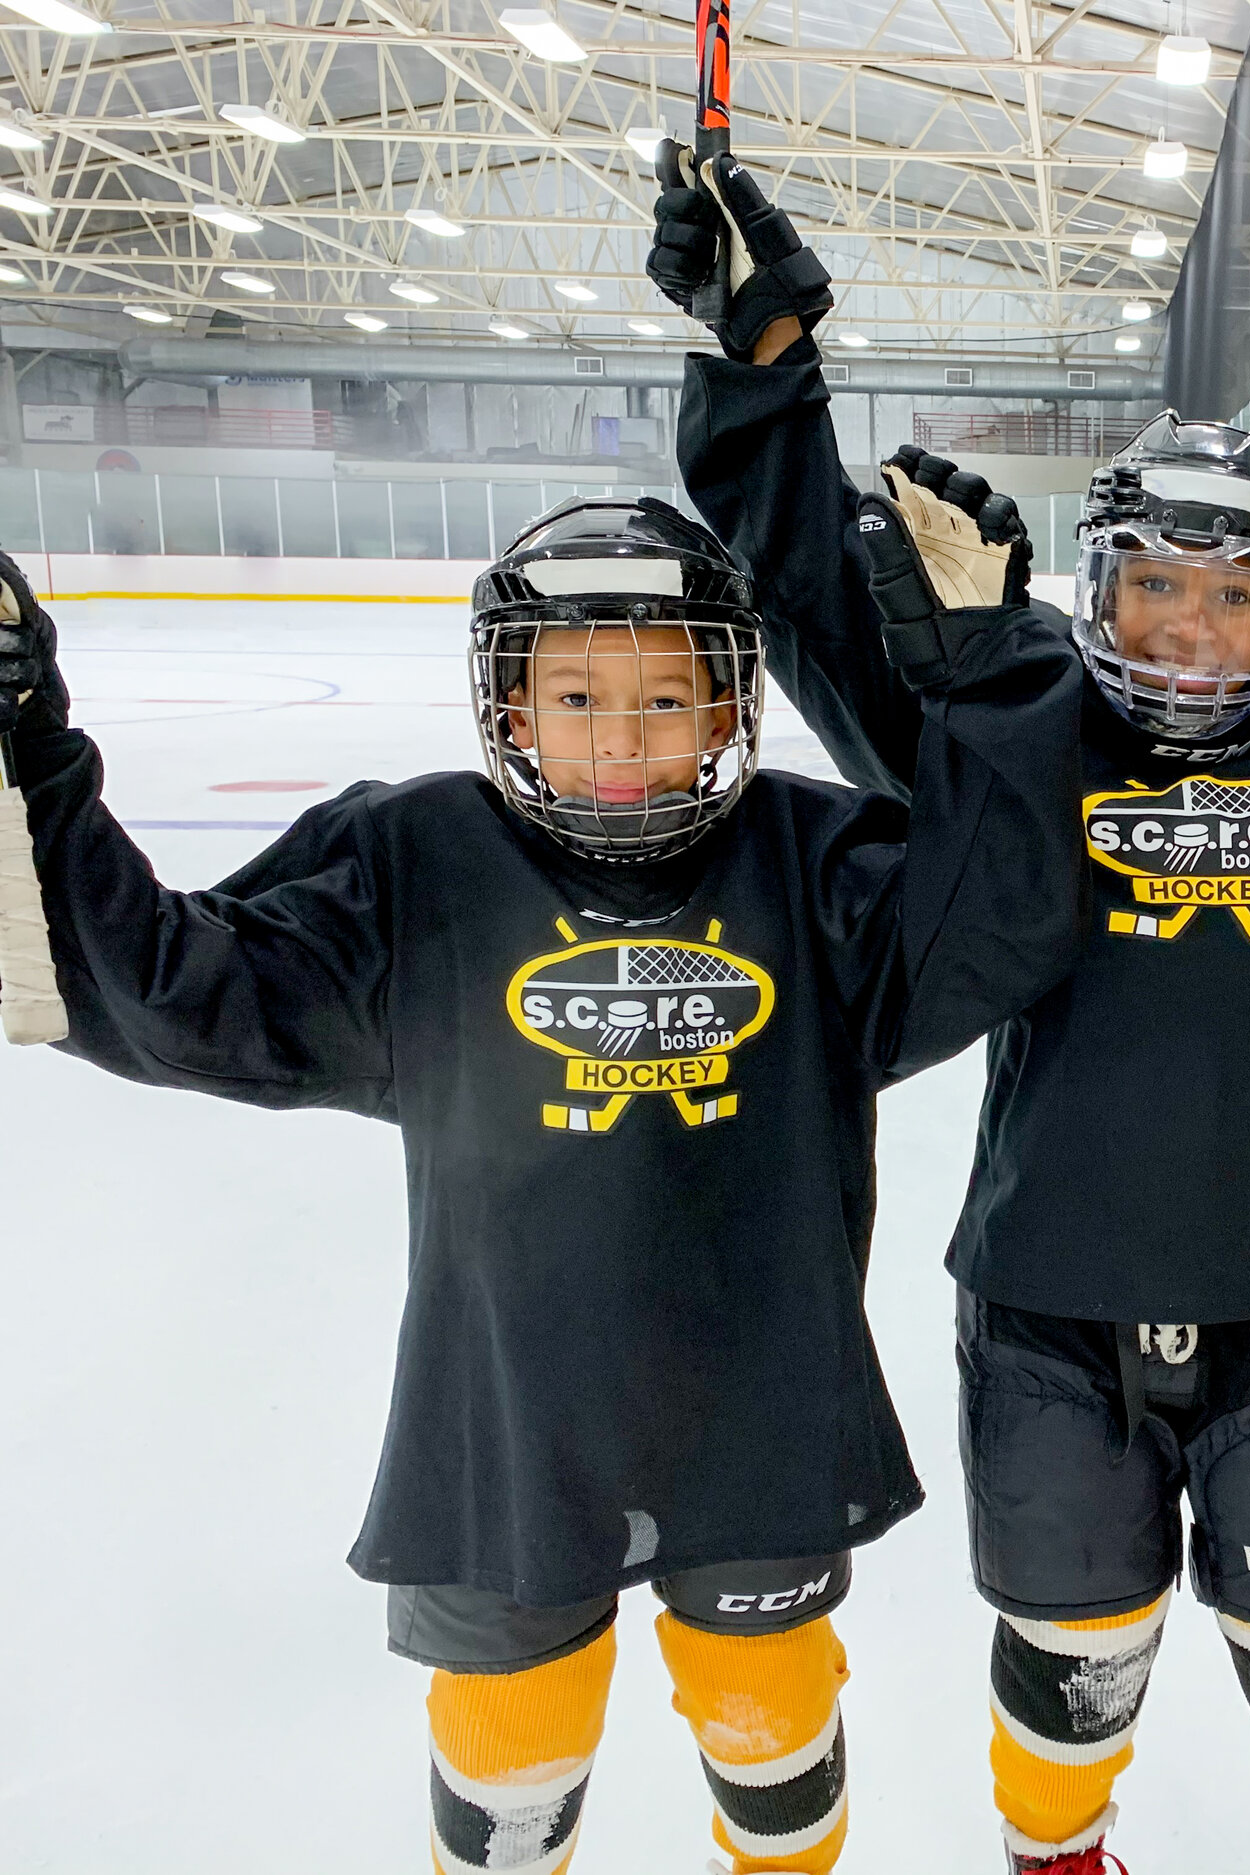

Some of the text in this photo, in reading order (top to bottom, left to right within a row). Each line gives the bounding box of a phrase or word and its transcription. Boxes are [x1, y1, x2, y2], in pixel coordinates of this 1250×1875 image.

[660, 1029, 735, 1051] boston
[582, 1059, 714, 1088] HOCKEY
[716, 1571, 831, 1613] CCM
